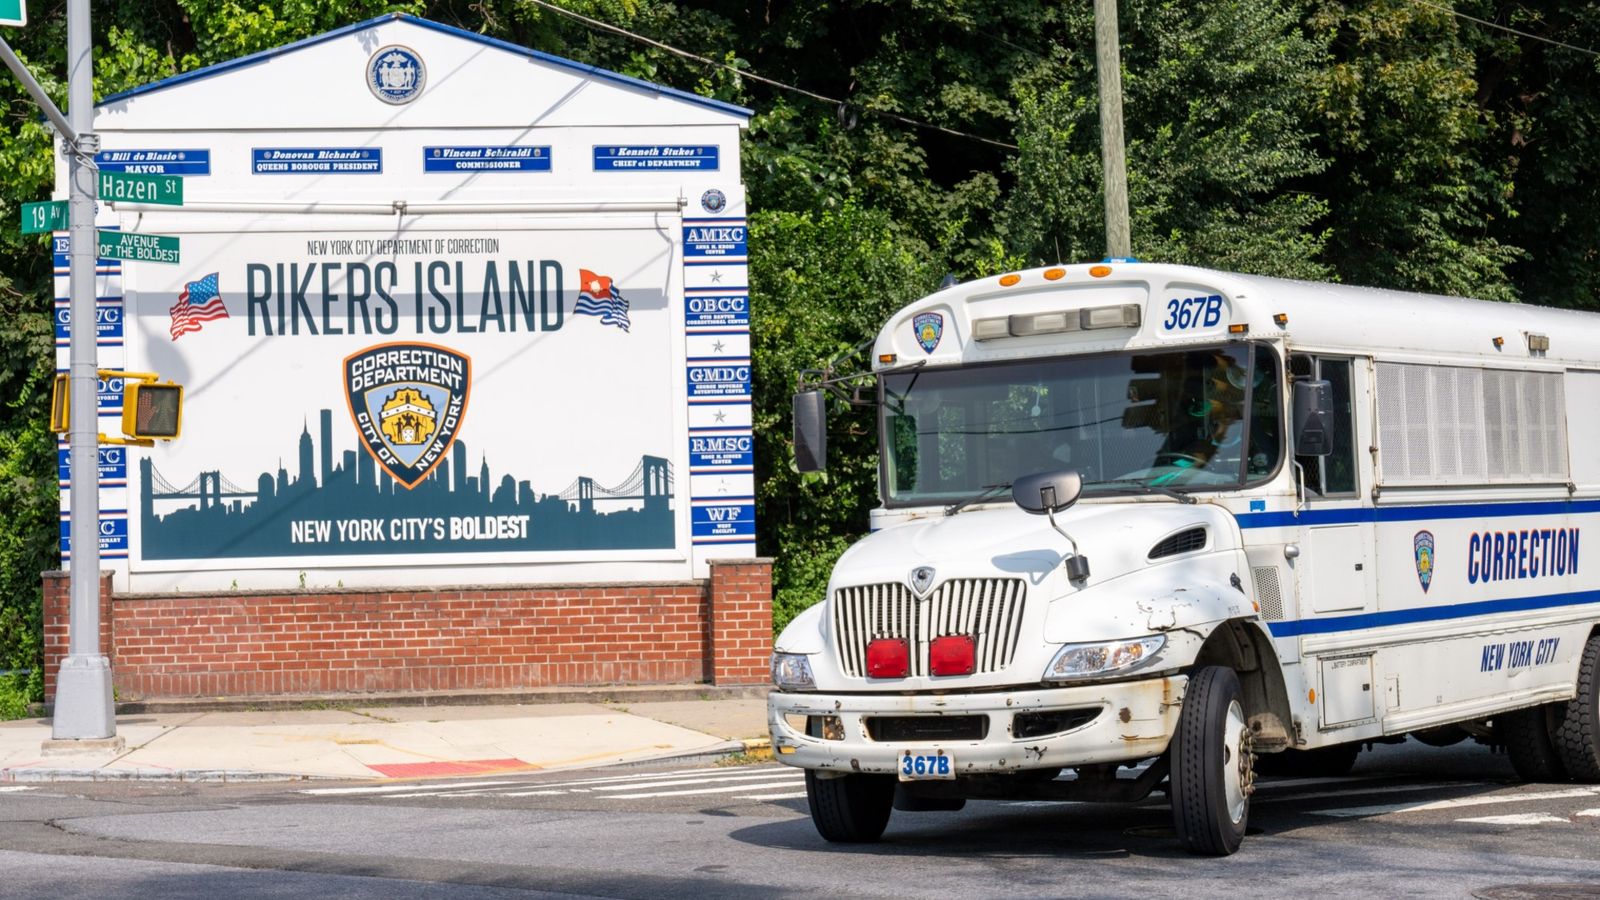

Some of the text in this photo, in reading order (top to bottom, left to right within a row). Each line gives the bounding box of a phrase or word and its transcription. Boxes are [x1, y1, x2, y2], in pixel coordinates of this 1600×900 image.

[112, 152, 177, 161] Bill de Blasio
[272, 150, 361, 159] Donovan Richards
[443, 148, 532, 158] Vincent Schiraldi
[618, 147, 695, 156] Kenneth Stukes
[125, 165, 165, 173] MAYOR
[256, 163, 288, 171] QUEENS
[333, 162, 378, 170] PRESIDENT
[456, 161, 521, 169] COMMISSIONER
[103, 175, 176, 200] Hazen St
[32, 205, 61, 228] 19 Av
[121, 235, 160, 249] AVENUE
[687, 228, 744, 242] AMKC
[100, 244, 179, 262] OF THE BOLDEST
[307, 238, 500, 255] NEW YORK CITY DEPARTMENT OF CORRECTION
[247, 260, 564, 336] RIKERS ISLAND
[689, 298, 745, 312] OBCC
[1164, 295, 1223, 330] 367B
[351, 350, 462, 376] CORRECTION
[352, 366, 462, 392] DEPARTMENT
[690, 367, 749, 382] GMDC
[358, 411, 399, 466] CITY OF
[415, 394, 462, 472] NEW YORK
[692, 437, 751, 452] RMSC
[706, 507, 741, 521] WF
[291, 515, 530, 543] NEW YORK CITY'S BOLDEST
[1467, 527, 1580, 584] CORRECTION
[1480, 637, 1560, 672] NEW YORK CITY
[902, 755, 950, 775] 367B
